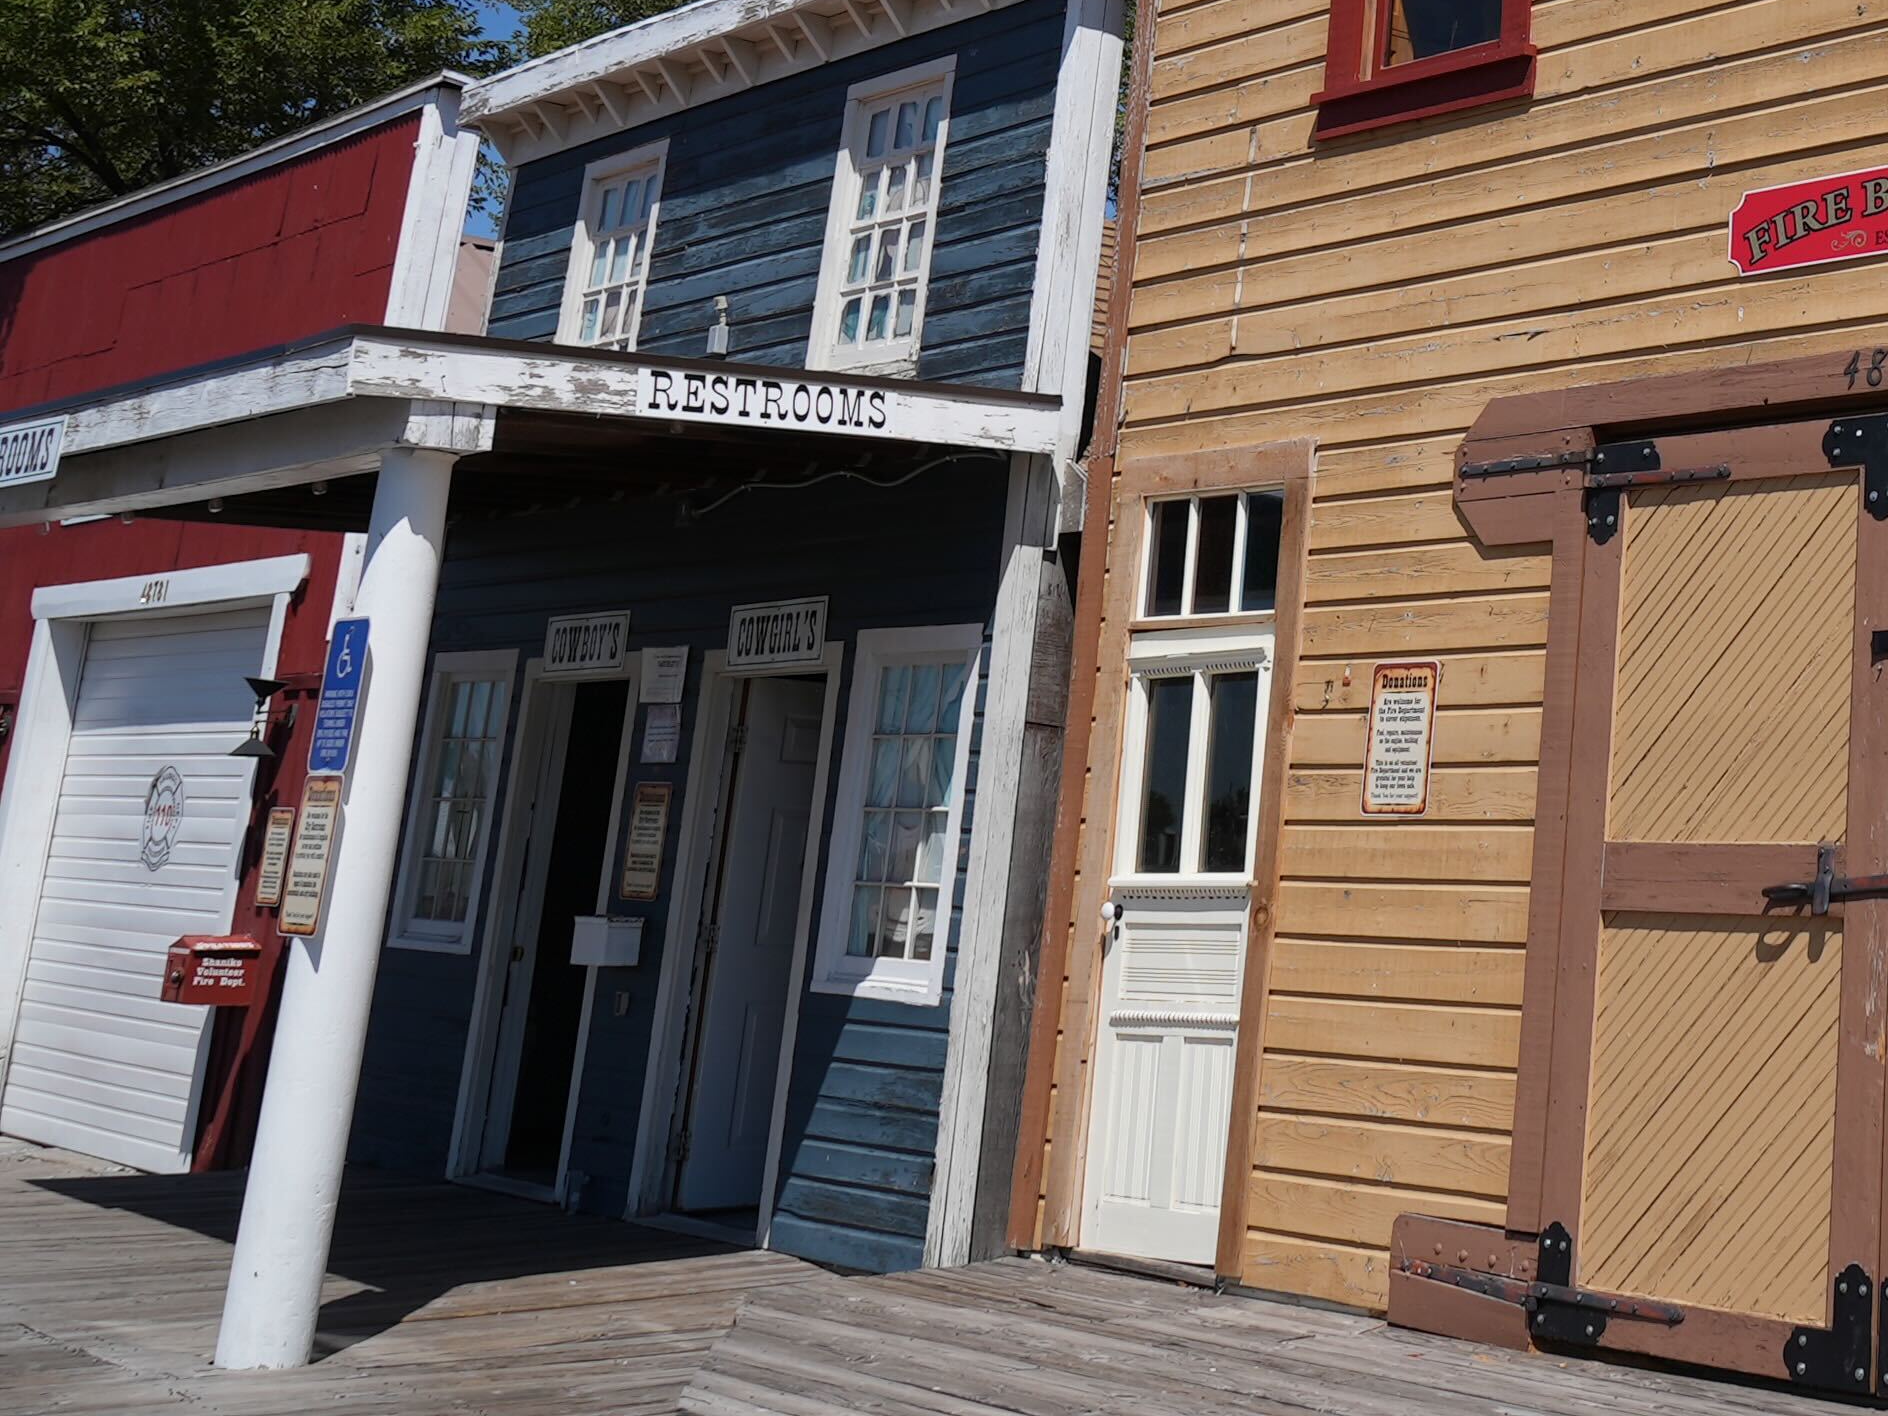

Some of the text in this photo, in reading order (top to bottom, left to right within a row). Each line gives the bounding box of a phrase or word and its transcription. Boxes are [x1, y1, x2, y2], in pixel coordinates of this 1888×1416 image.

[1743, 188, 1852, 265] FIRE
[648, 370, 886, 429] RESTROOMS
[551, 622, 621, 665] COWBOY'S
[737, 609, 817, 658] COWGIRL'S
[1382, 673, 1428, 689] Donations
[196, 967, 245, 977] Volunteer
[202, 957, 243, 967] Shaniko
[192, 976, 246, 988] Fire Dept.
